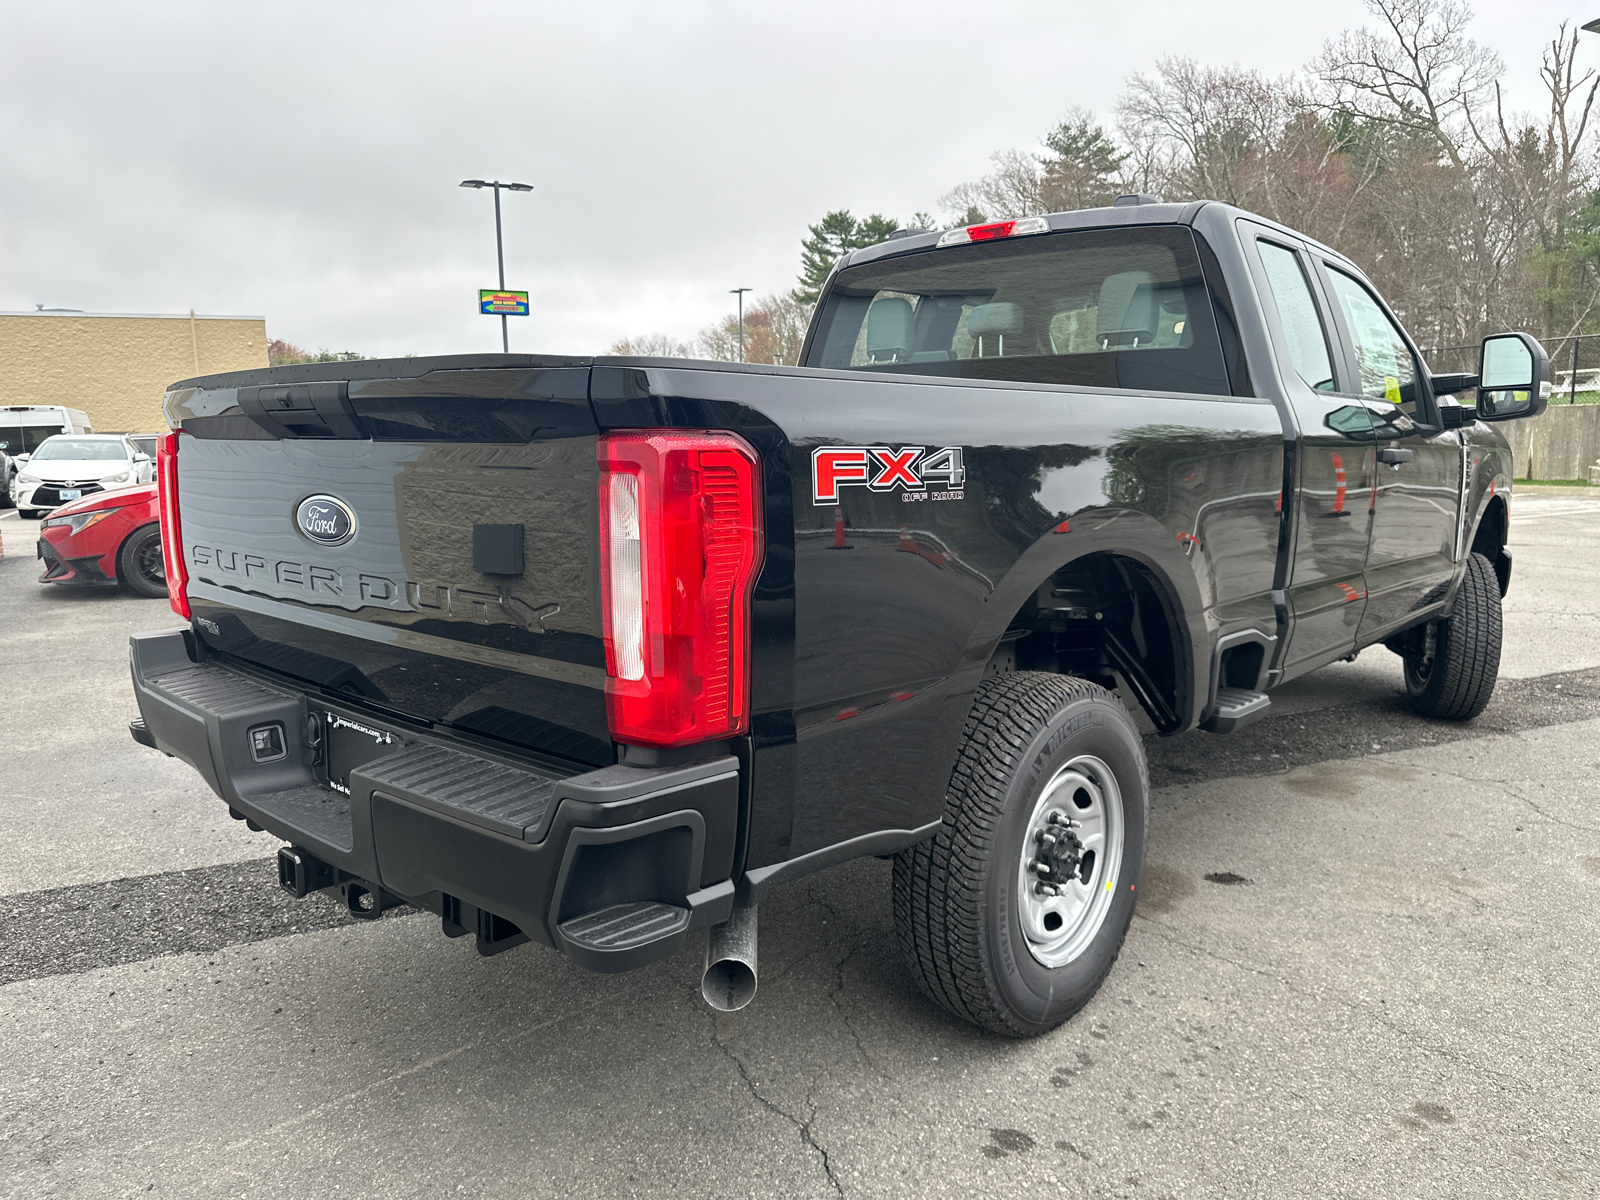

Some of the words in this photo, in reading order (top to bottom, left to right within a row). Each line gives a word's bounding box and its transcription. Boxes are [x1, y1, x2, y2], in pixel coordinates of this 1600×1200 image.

[811, 446, 965, 506] FX4
[902, 493, 928, 502] OFF
[932, 491, 965, 501] ROAD
[306, 505, 337, 535] Ford
[192, 545, 343, 596] SUPER
[359, 573, 560, 633] DUTY
[1048, 711, 1104, 753] MICHELIN
